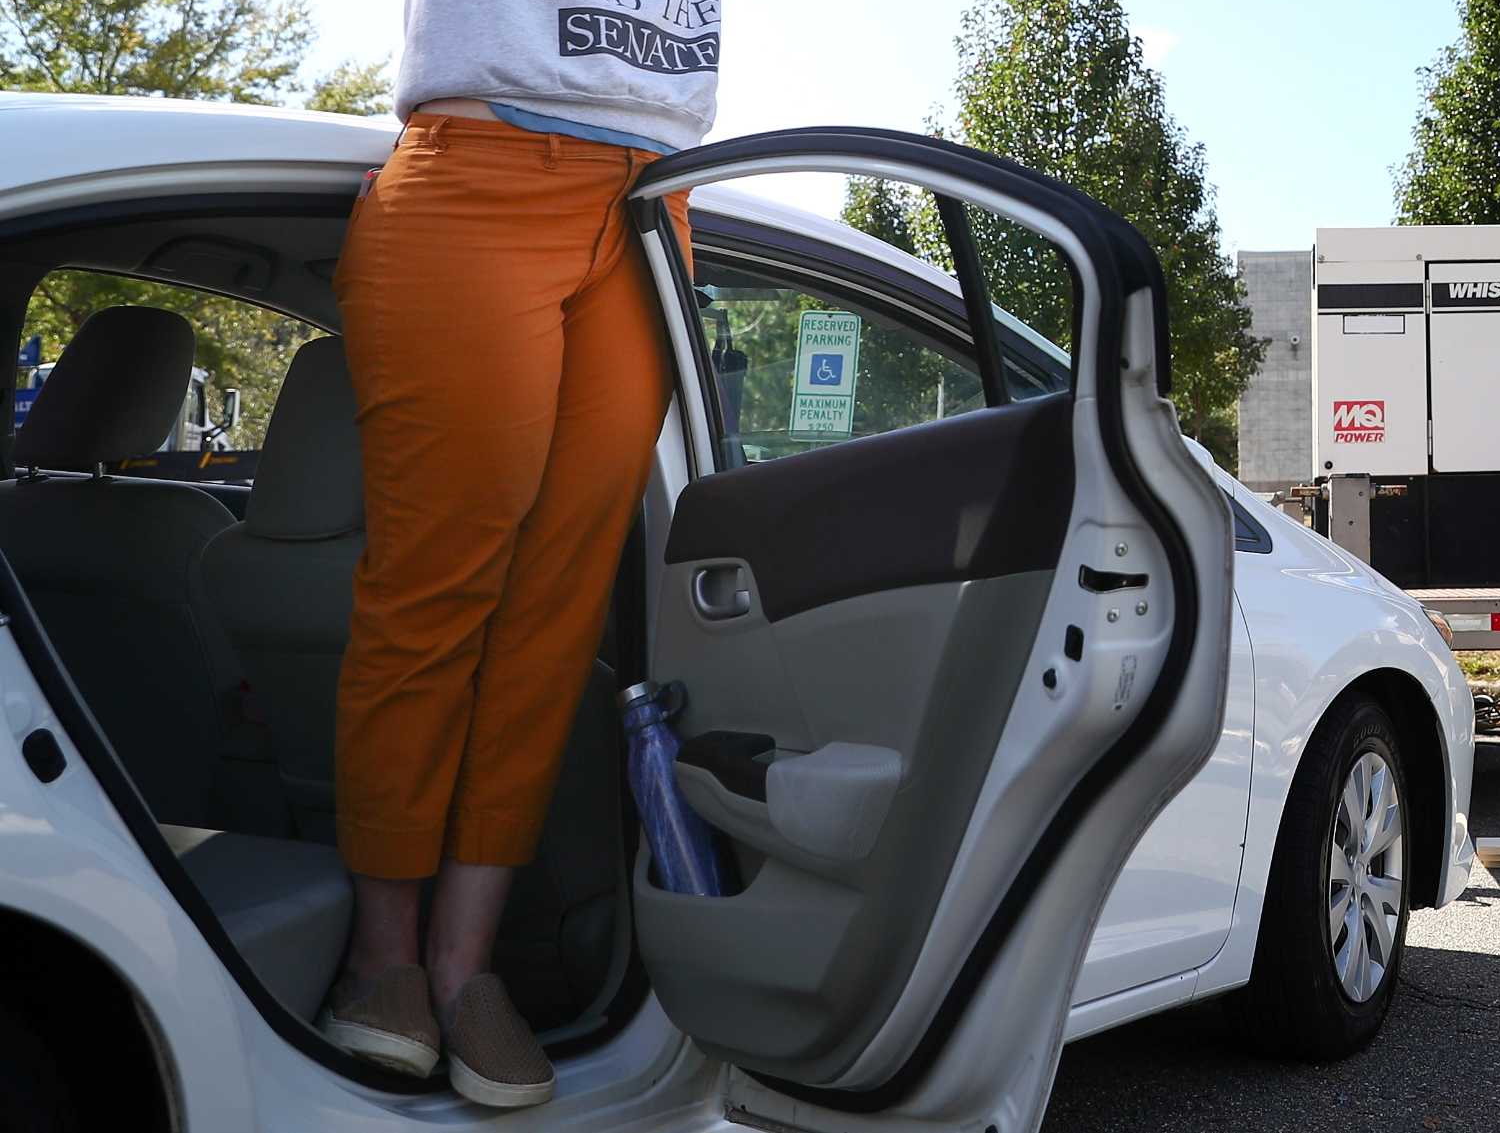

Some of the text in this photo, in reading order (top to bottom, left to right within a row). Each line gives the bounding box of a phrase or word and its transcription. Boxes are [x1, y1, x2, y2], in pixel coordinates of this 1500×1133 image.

[566, 13, 719, 71] SENATE
[803, 319, 857, 332] RESERVED
[806, 334, 852, 346] PARKING
[800, 399, 847, 409] MAXIMUM
[800, 409, 843, 420] PENALTY
[1333, 404, 1385, 428] MQ
[1334, 432, 1385, 443] POWER
